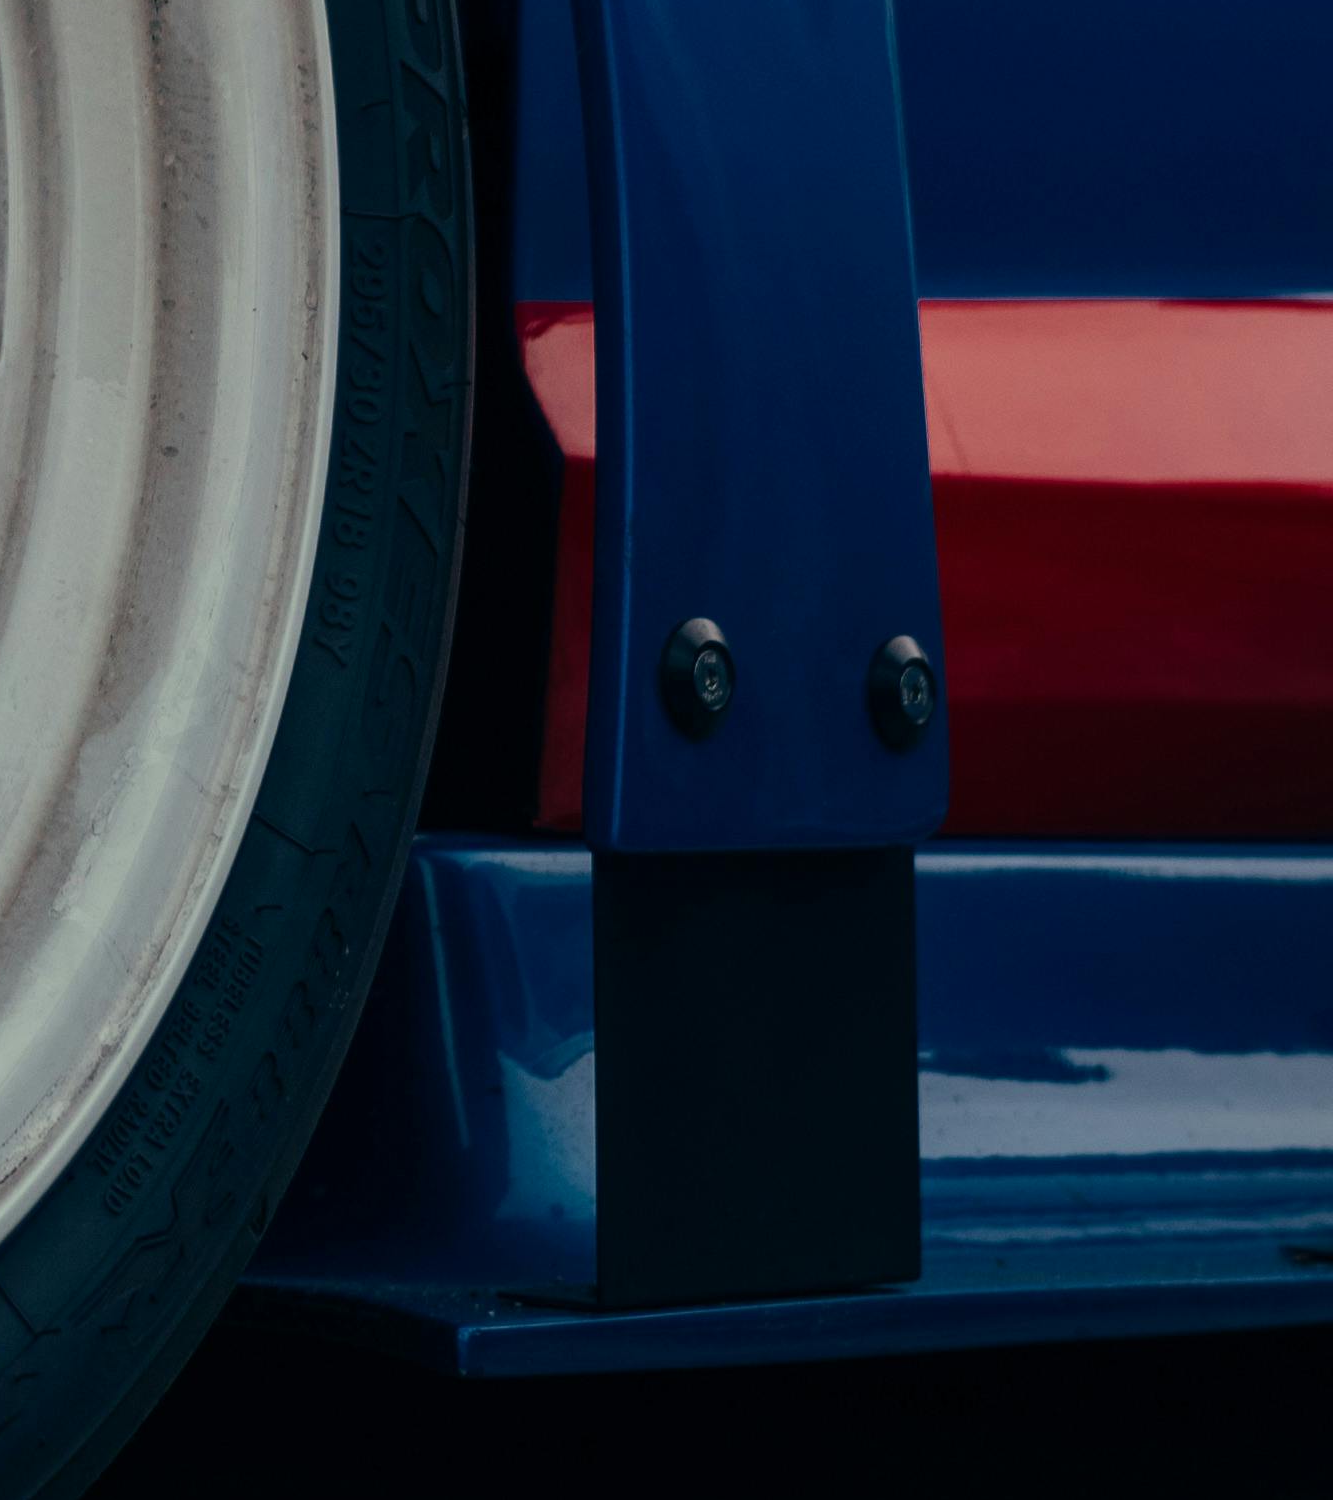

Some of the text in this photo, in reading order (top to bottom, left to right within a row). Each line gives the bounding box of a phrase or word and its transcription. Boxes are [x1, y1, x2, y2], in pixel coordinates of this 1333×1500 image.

[341, 233, 388, 435] 295/30
[308, 561, 363, 673] 98Y
[83, 910, 241, 1188] STEEL BELTED RADIAL
[97, 933, 265, 1225] TUBELESS EXTRA LOAD
